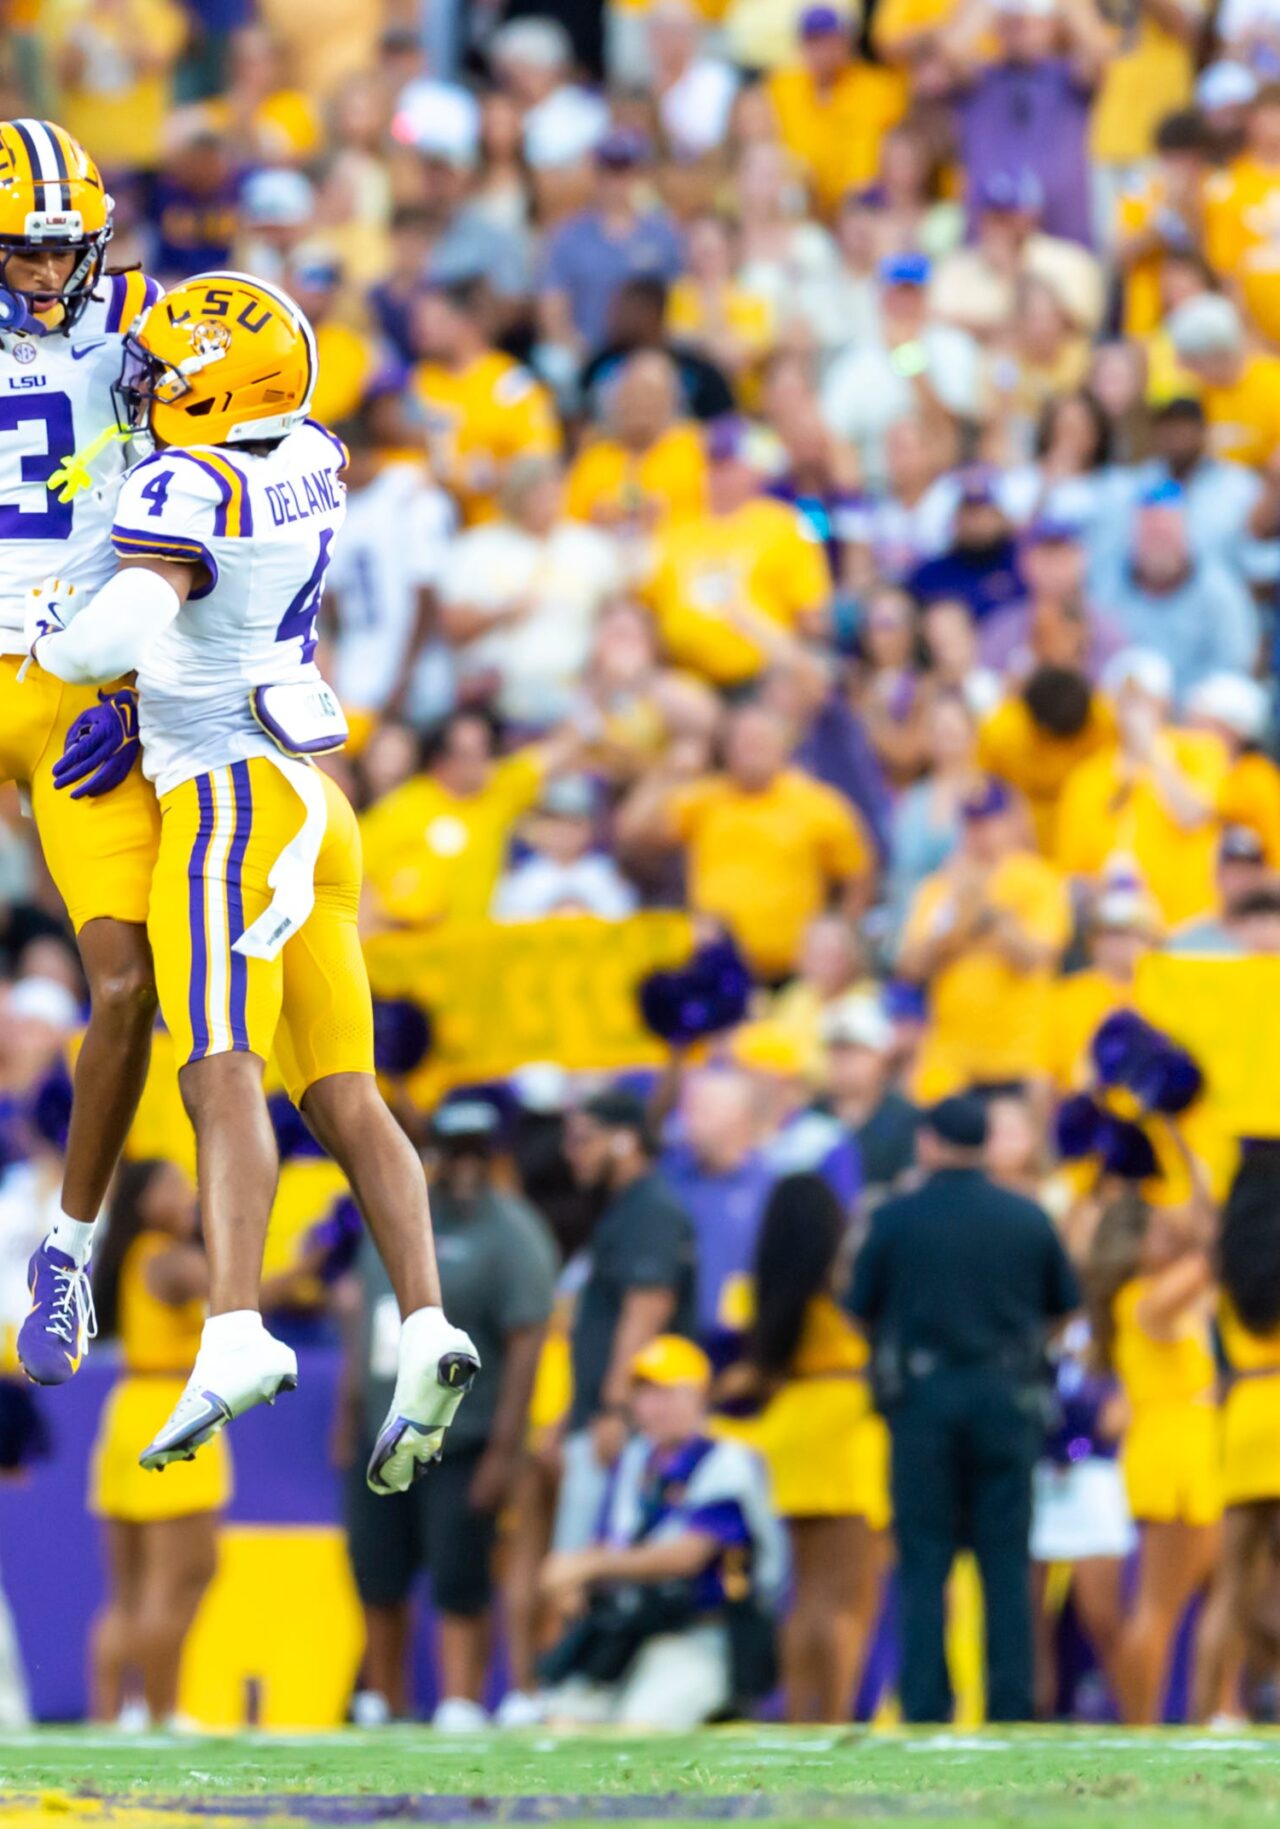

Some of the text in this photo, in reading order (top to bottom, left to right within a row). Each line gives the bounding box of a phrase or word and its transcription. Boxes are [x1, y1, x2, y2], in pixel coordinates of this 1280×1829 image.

[166, 289, 273, 334] LSU
[9, 375, 47, 389] LSU
[140, 470, 176, 518] 4
[274, 527, 334, 665] 4
